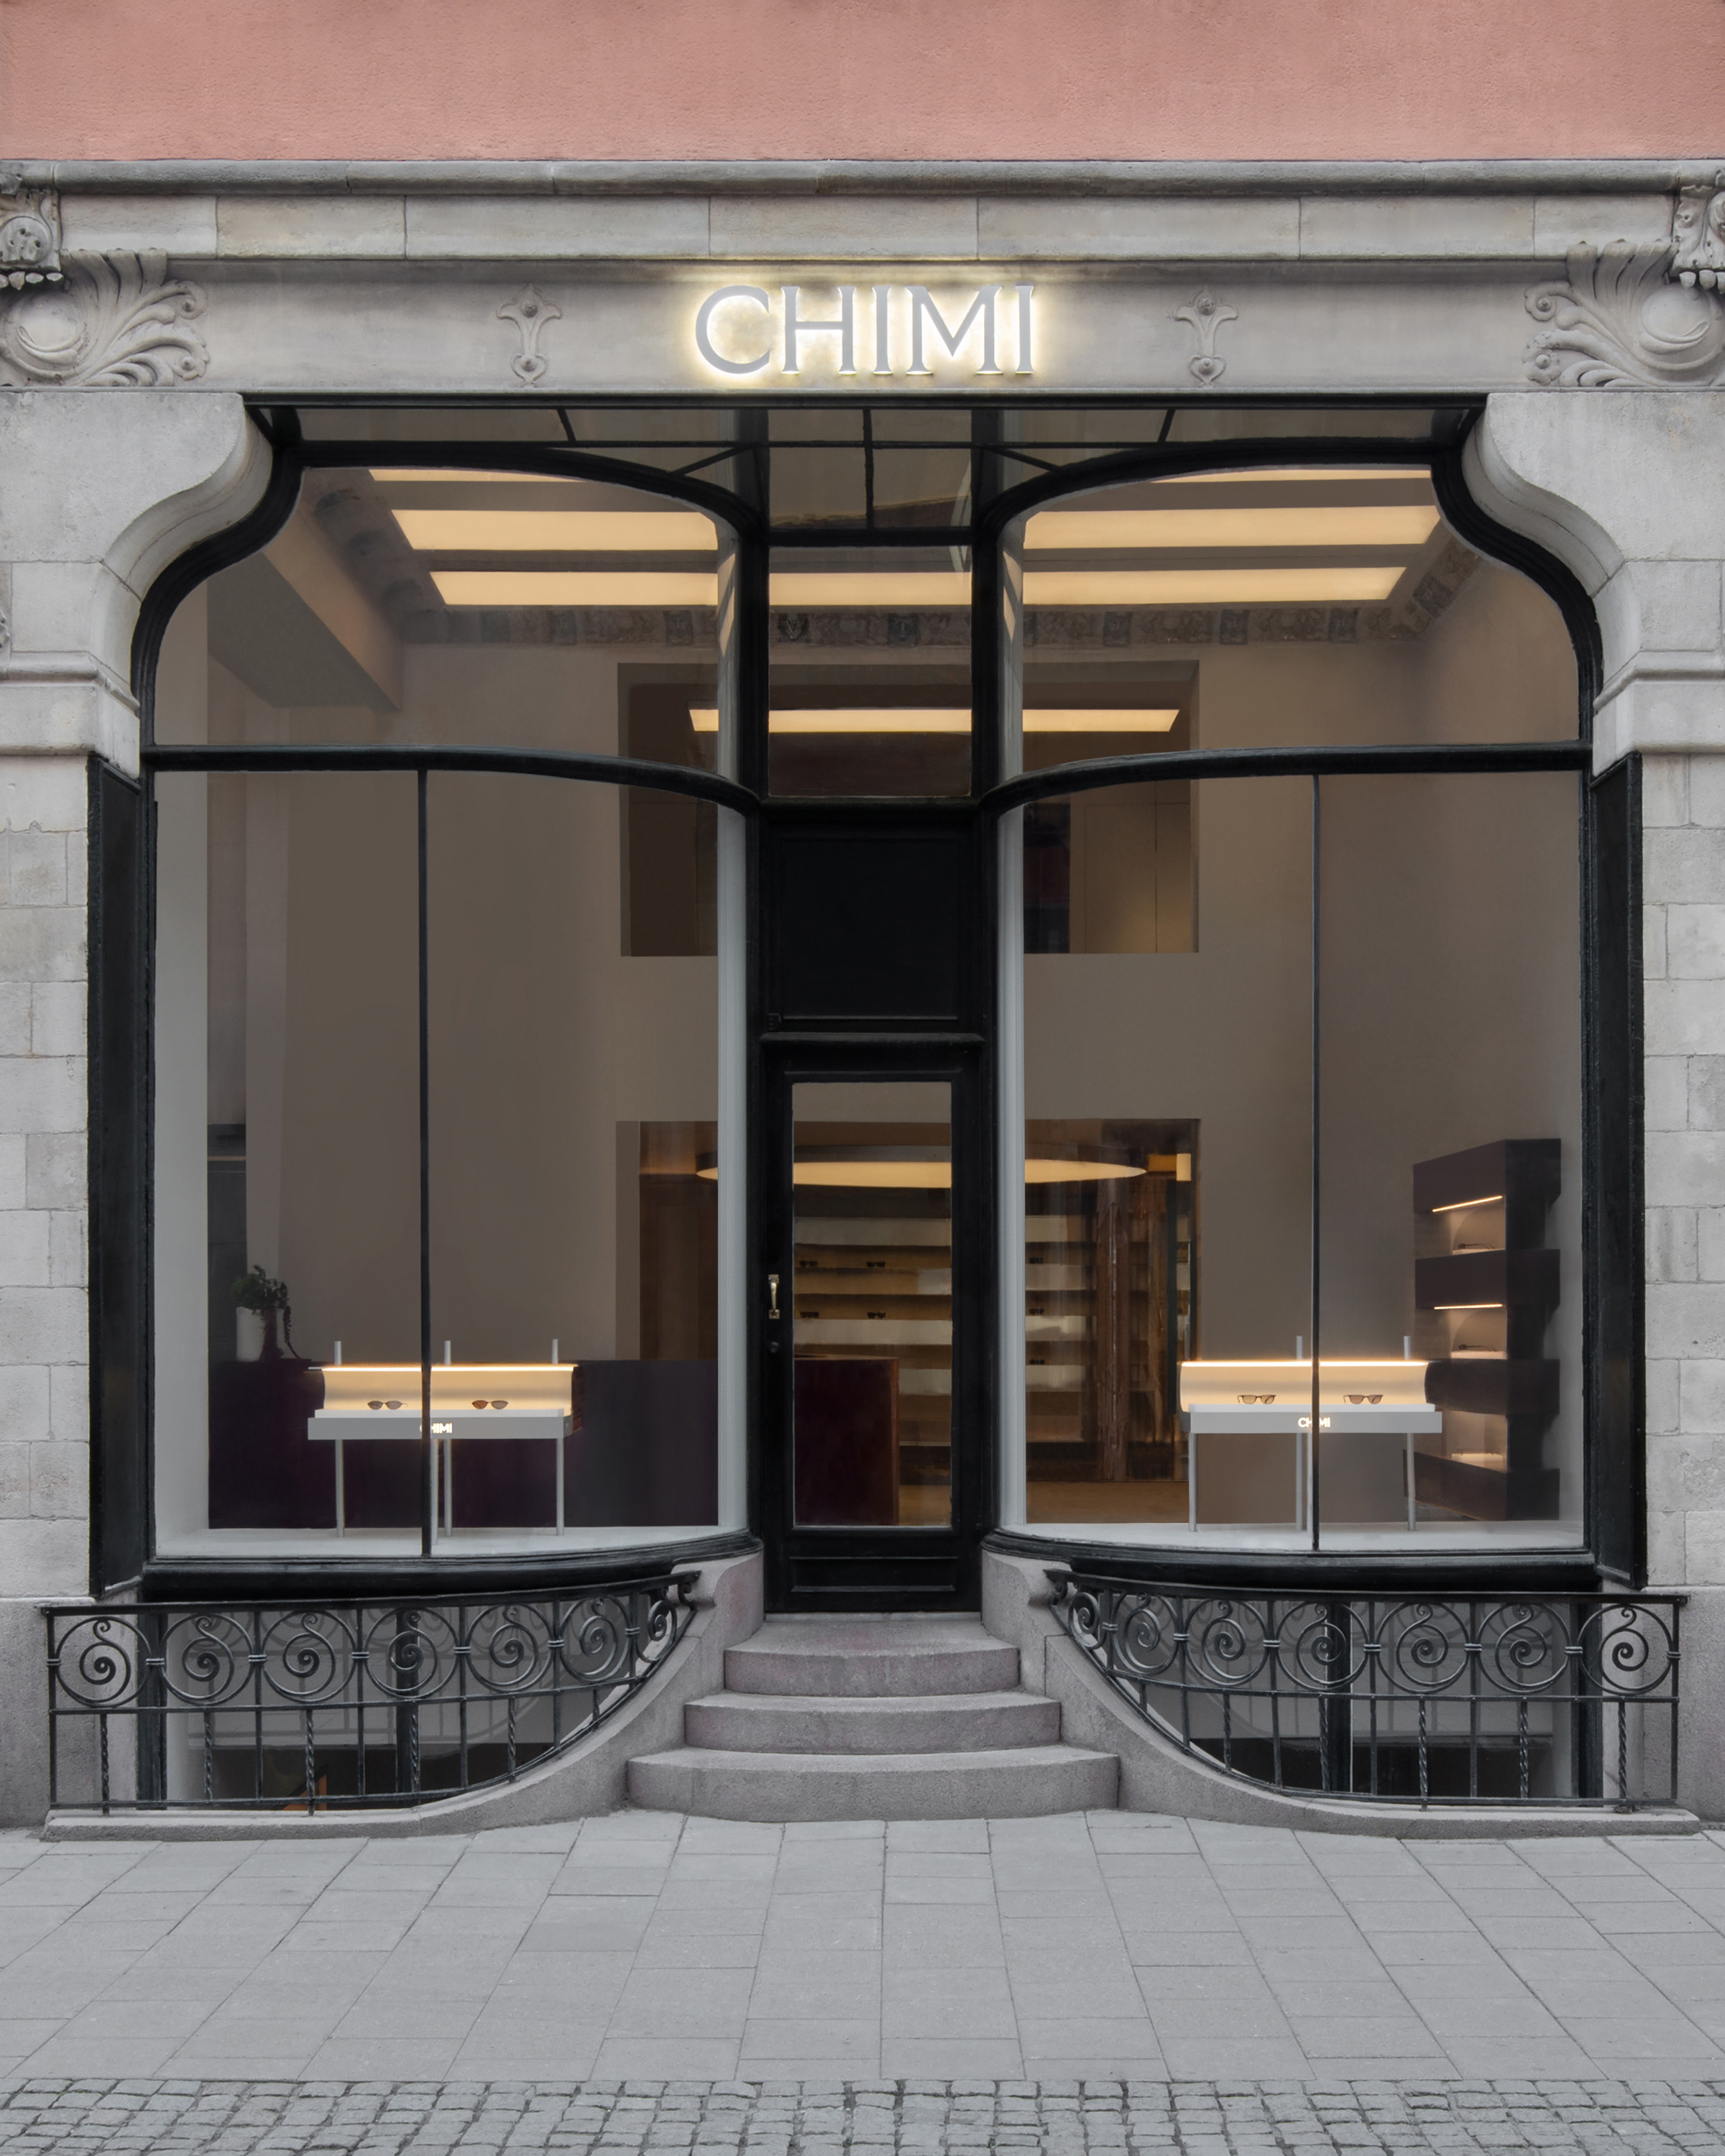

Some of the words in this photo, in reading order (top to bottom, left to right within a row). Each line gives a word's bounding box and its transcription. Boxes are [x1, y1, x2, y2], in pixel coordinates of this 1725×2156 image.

[696, 285, 1034, 375] CHIMI
[419, 1422, 453, 1434] HIMI
[1297, 1416, 1331, 1428] CHMI
